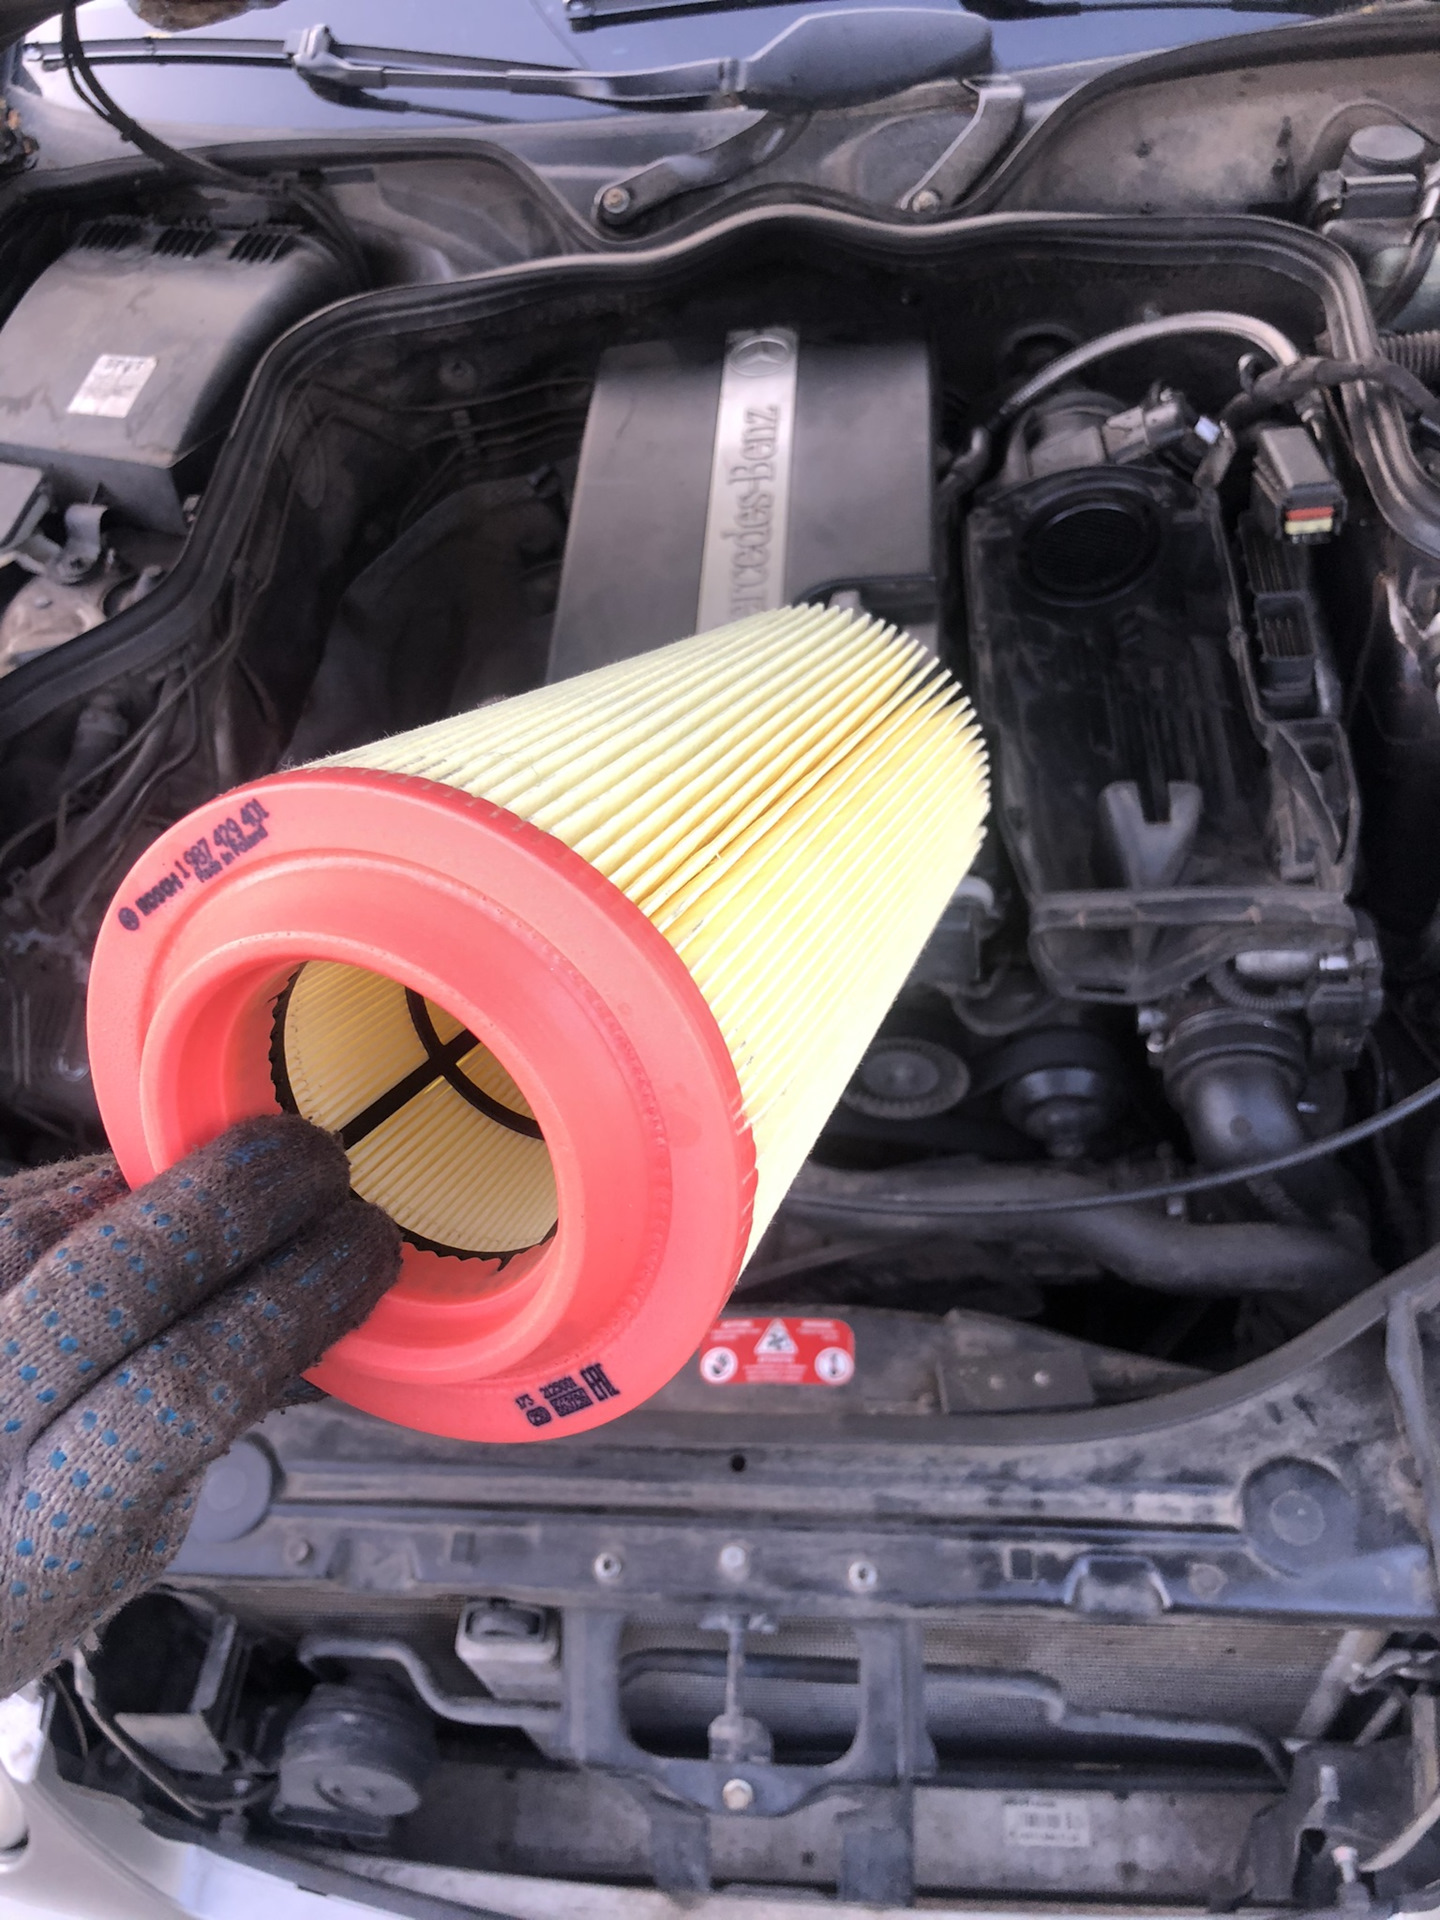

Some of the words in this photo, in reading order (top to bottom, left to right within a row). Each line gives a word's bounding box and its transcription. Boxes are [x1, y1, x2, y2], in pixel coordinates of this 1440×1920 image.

[720, 404, 779, 619] ercedes-Benz
[174, 860, 190, 879] 1
[213, 818, 243, 849] 429
[240, 798, 269, 828] 401
